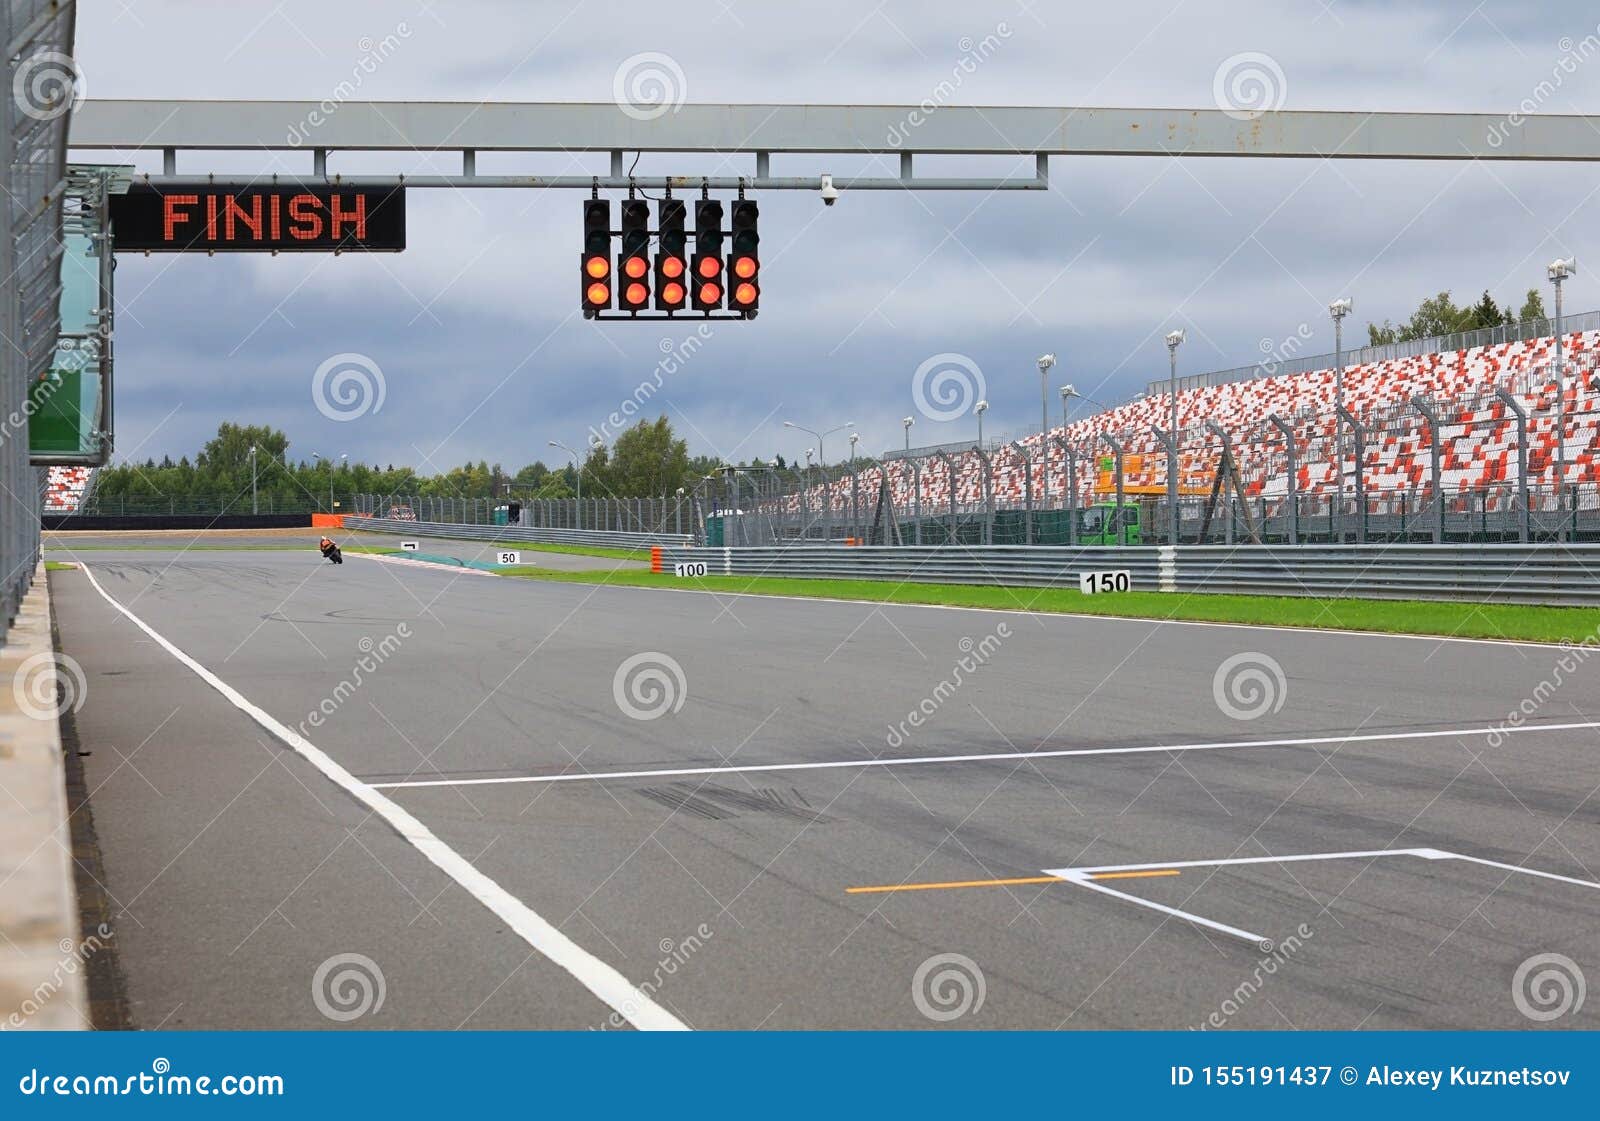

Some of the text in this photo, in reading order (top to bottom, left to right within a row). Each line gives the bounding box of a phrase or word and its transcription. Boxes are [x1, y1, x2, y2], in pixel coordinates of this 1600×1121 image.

[164, 194, 366, 240] FINISH
[502, 553, 516, 563] 50
[678, 563, 705, 577] 100
[1086, 572, 1129, 594] 150
